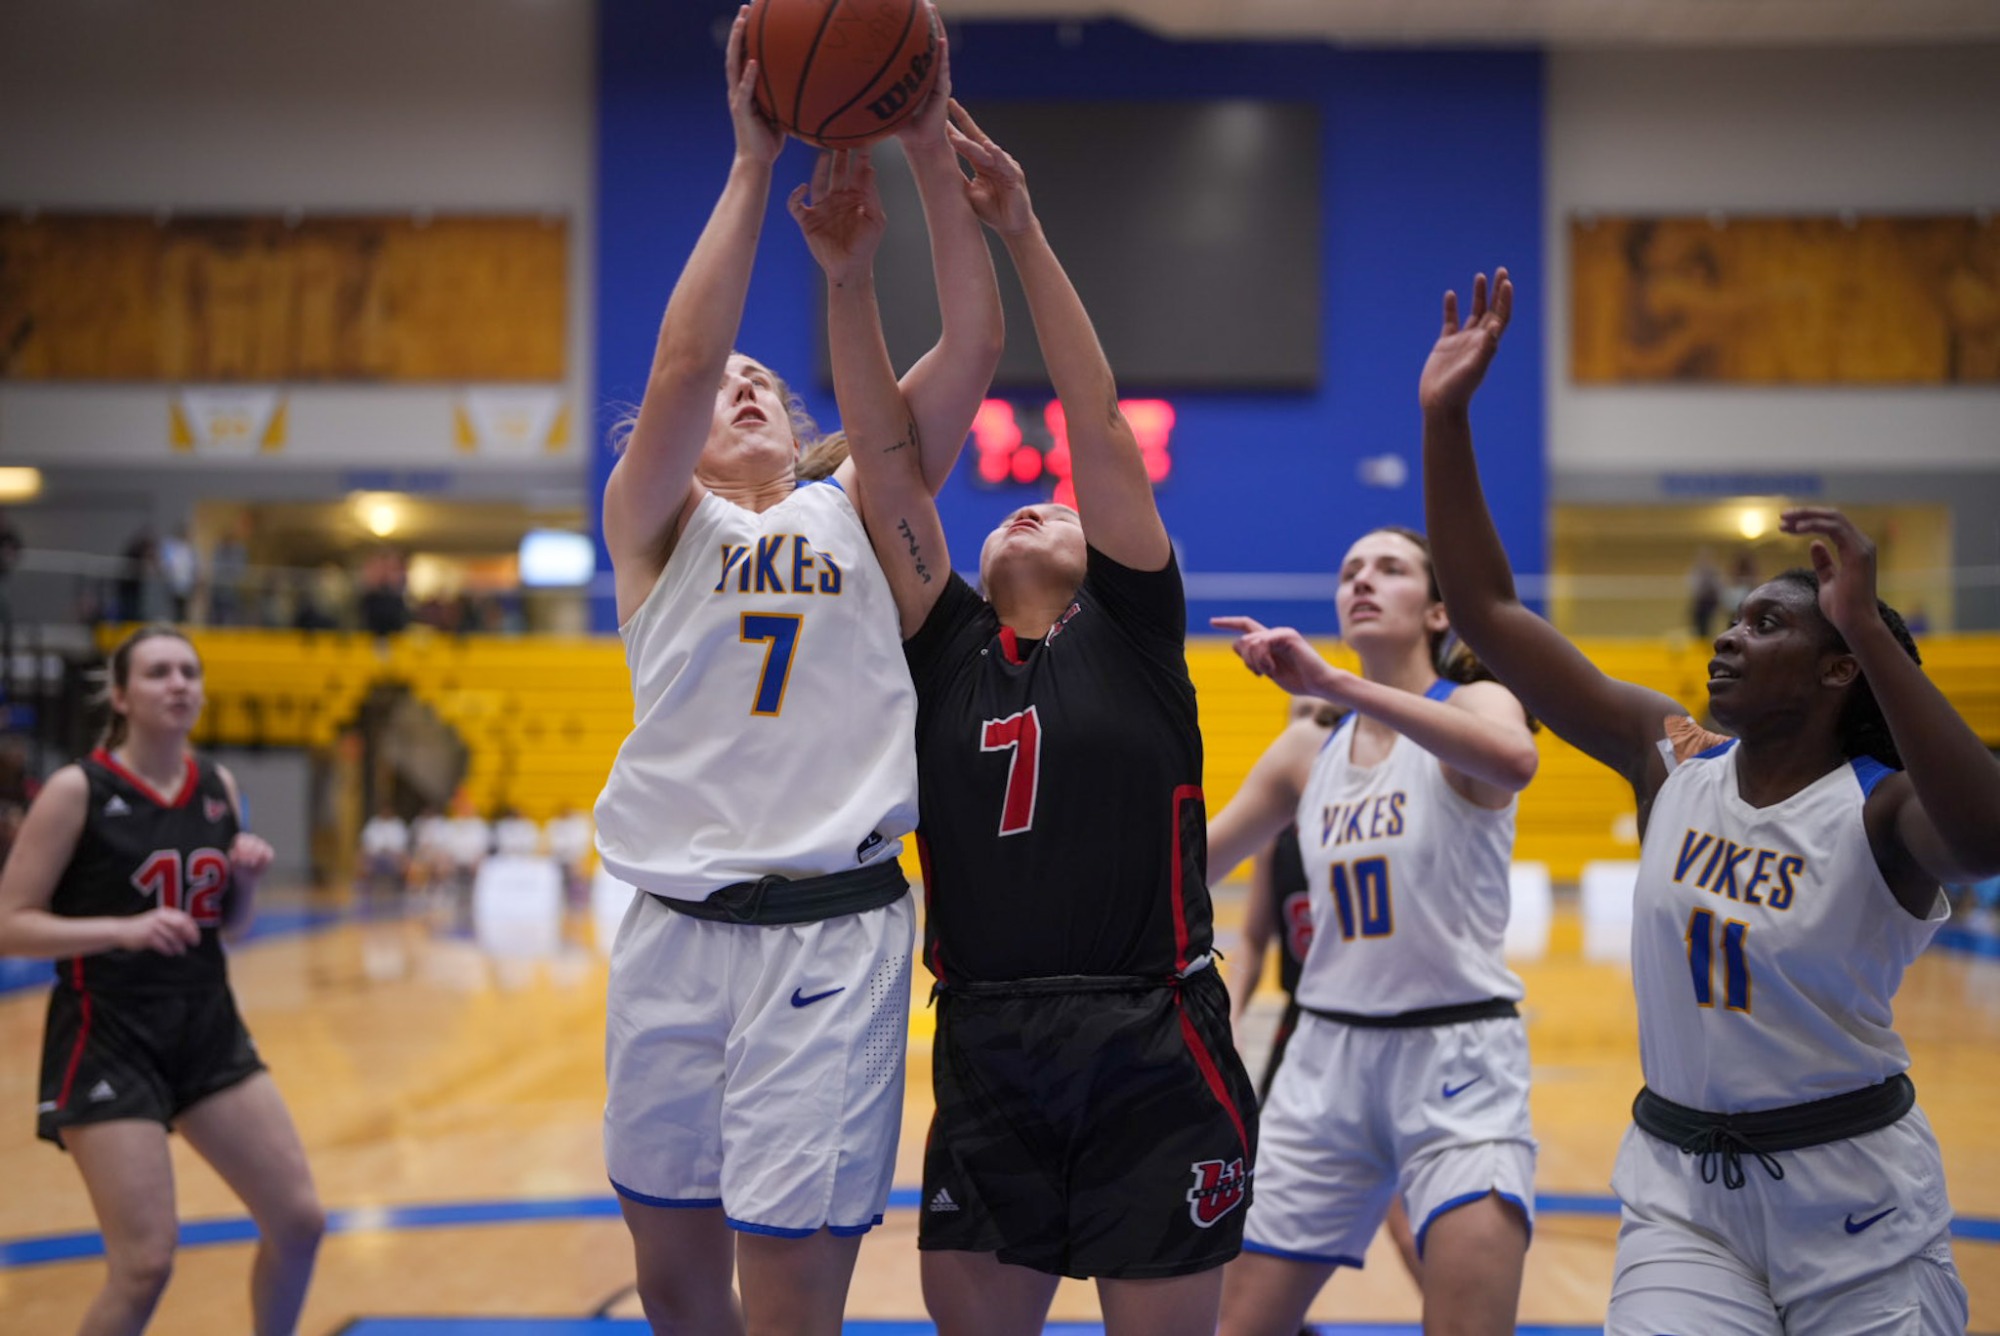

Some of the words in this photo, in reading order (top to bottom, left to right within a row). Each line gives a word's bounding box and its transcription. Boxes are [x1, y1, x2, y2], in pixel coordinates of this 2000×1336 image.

[714, 533, 842, 595] VIKES
[740, 611, 804, 717] 7
[980, 704, 1042, 837] 7
[1321, 791, 1406, 848] VIKES
[130, 847, 229, 928] 12
[1329, 854, 1395, 942] 10
[1672, 828, 1804, 911] VIKES
[1684, 907, 1751, 1015] 11
